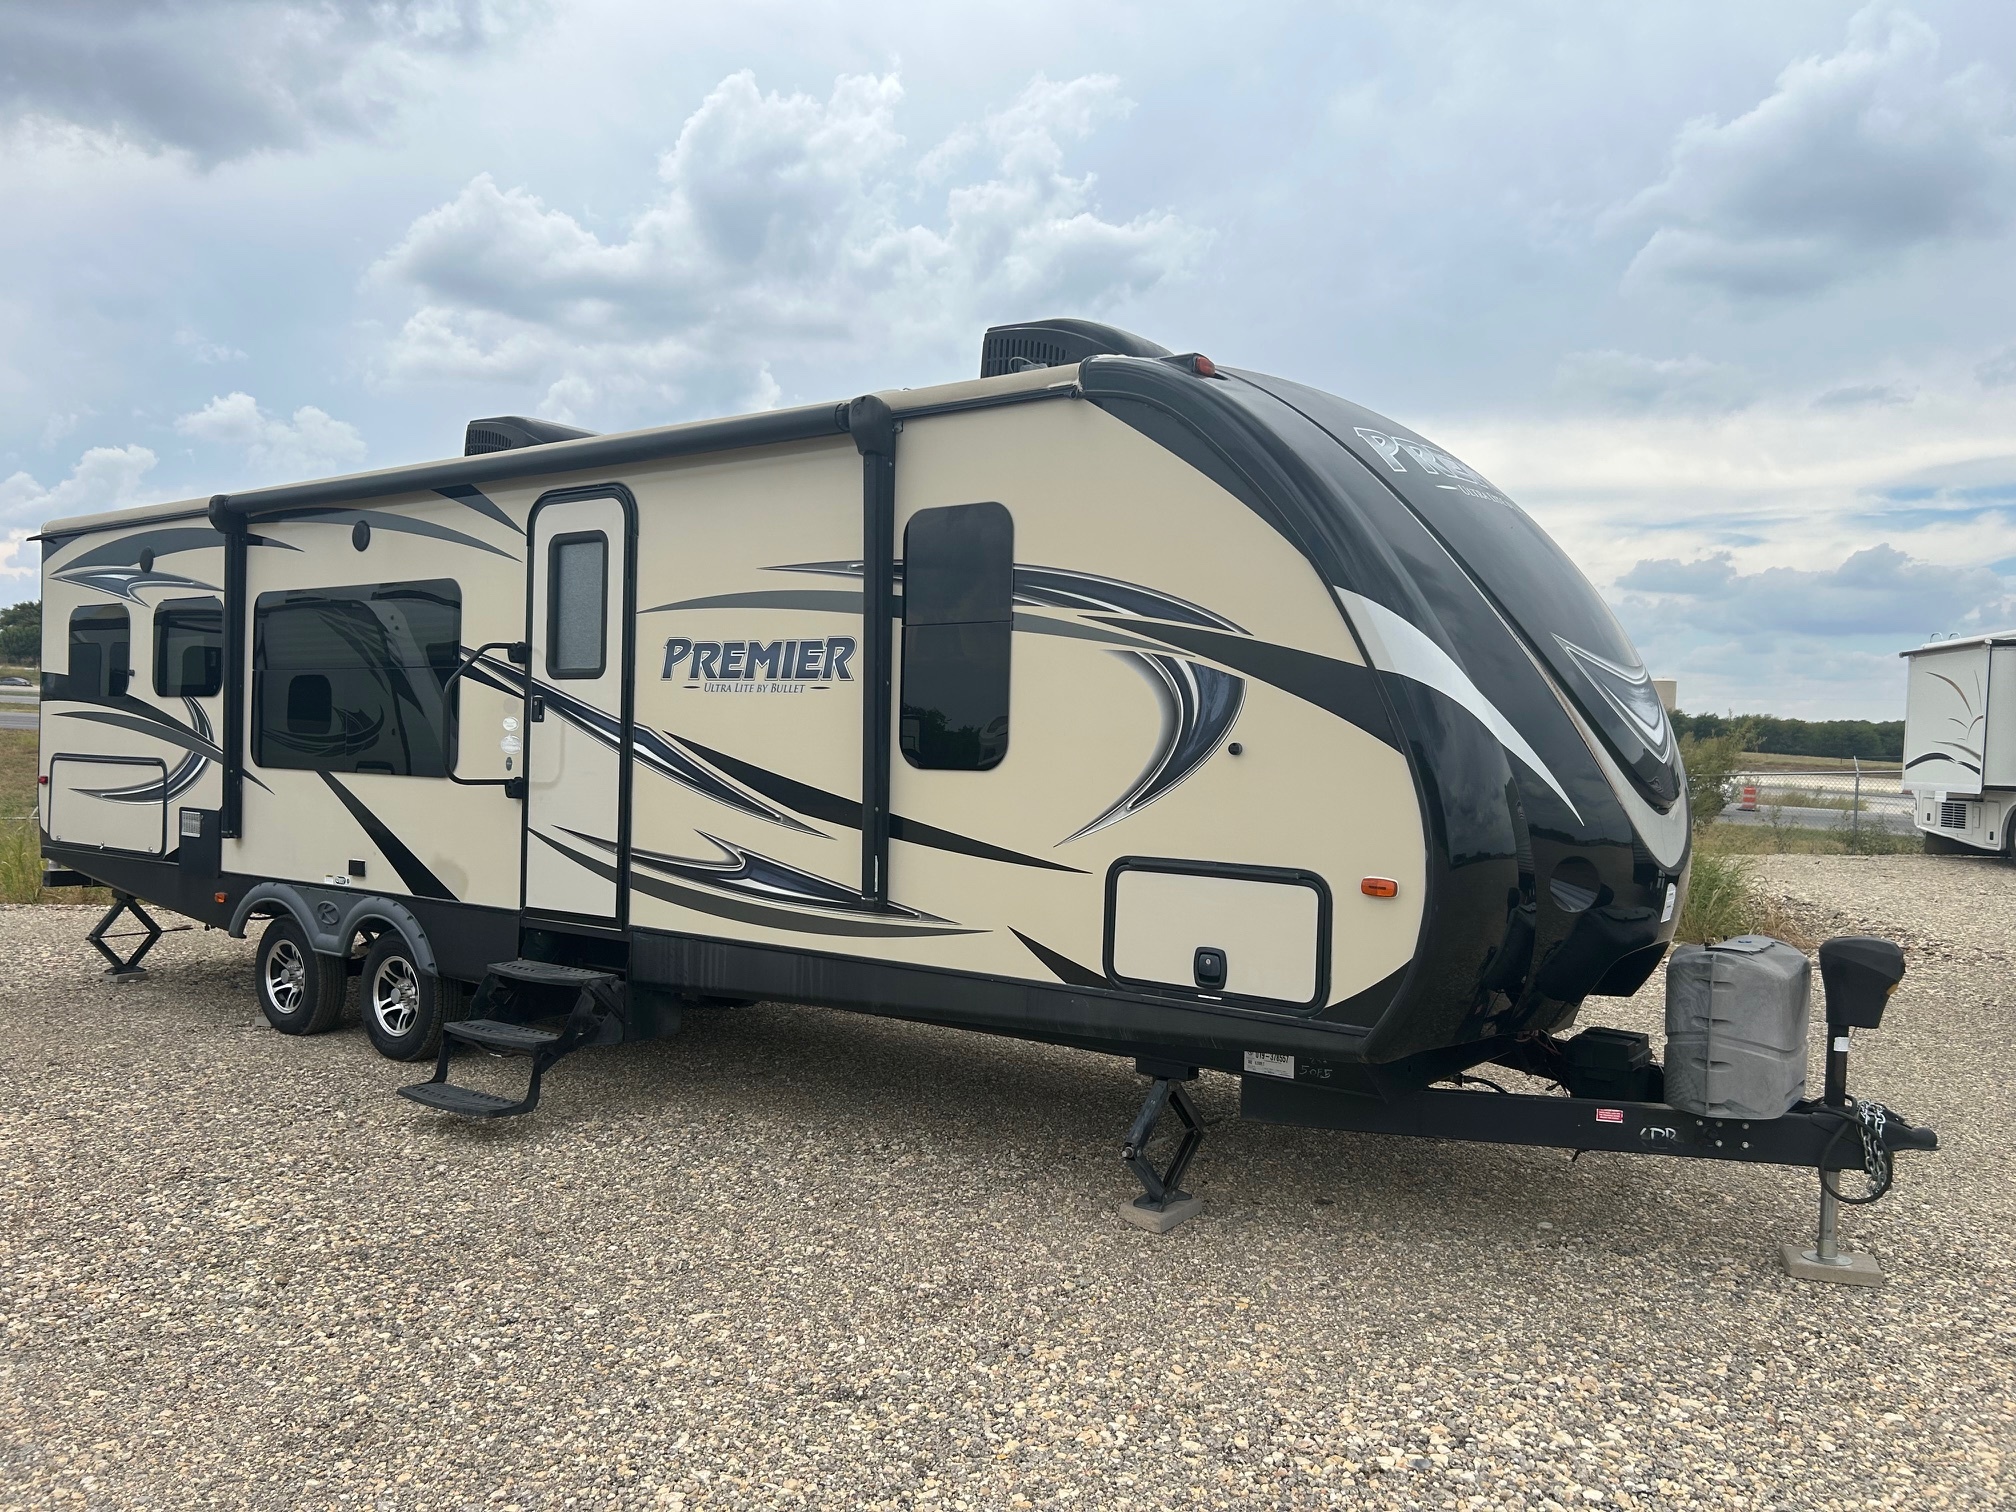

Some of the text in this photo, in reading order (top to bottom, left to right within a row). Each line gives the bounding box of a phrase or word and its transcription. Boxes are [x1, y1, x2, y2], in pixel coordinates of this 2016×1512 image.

[661, 636, 857, 681] PREMIER
[704, 683, 806, 694] ULTRA LITE BY BULLET
